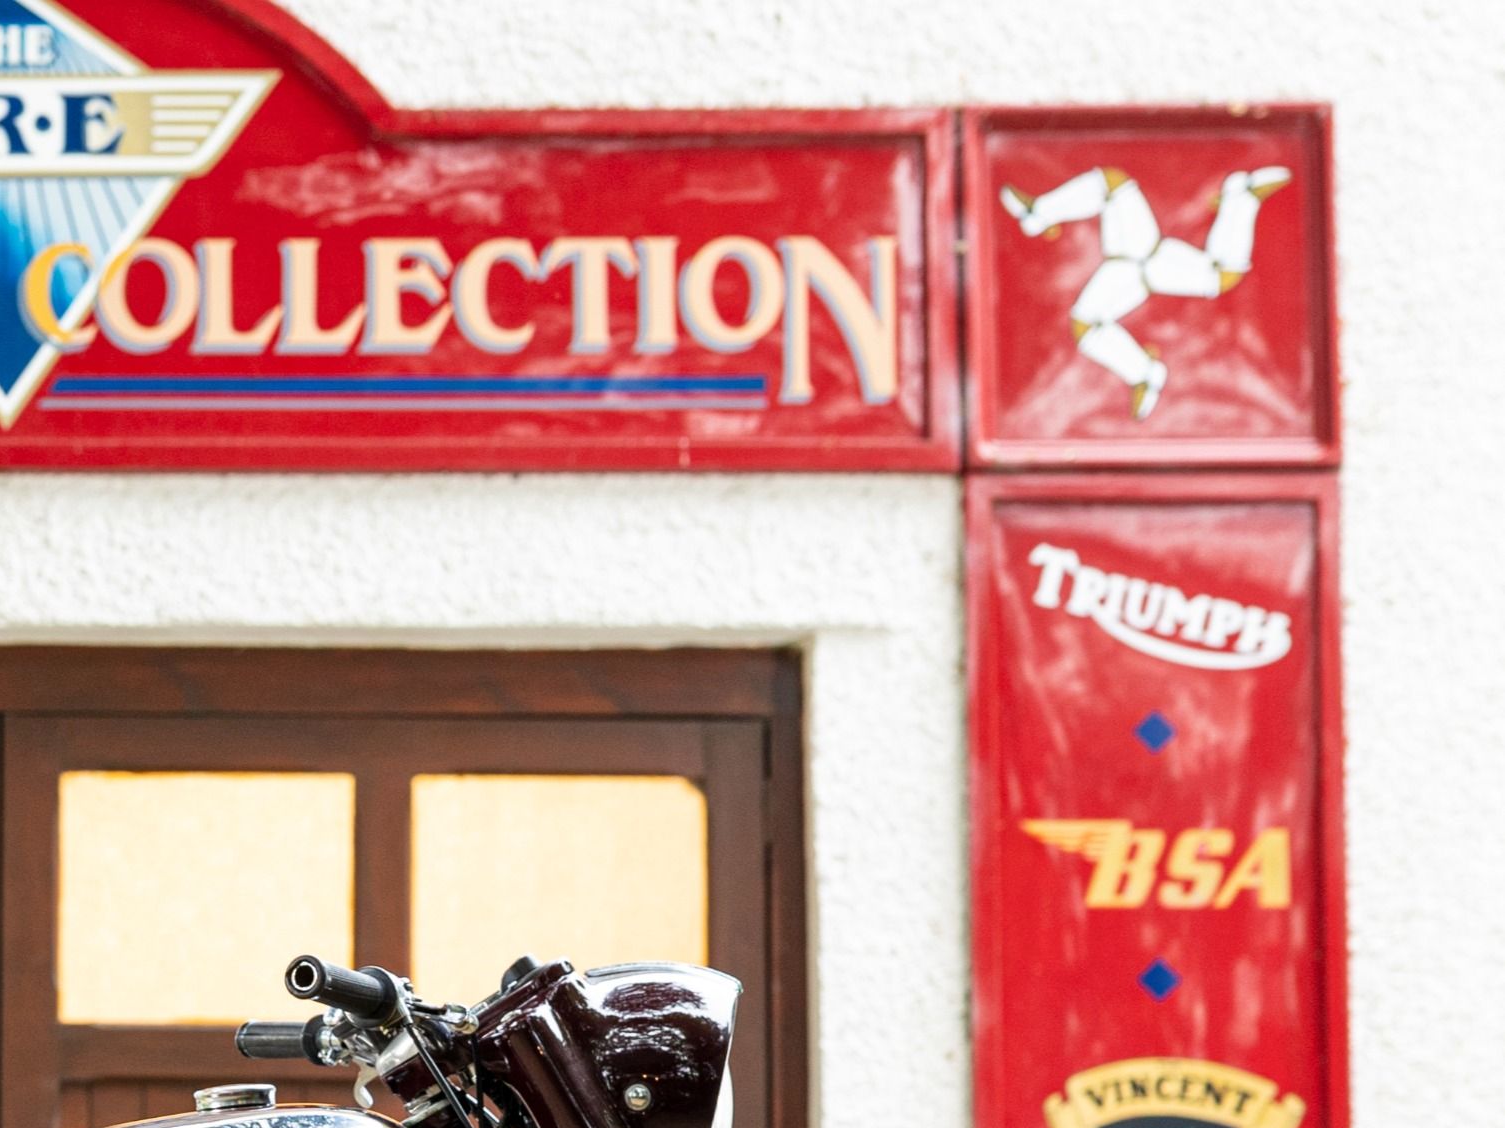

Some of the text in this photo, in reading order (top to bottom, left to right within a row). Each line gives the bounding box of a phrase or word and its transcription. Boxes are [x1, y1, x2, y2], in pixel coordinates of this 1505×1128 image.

[18, 236, 898, 406] COLLECTION
[1028, 541, 1293, 671] TRIUMPH
[1021, 818, 1292, 910] BSA
[1084, 1071, 1259, 1117] VINCENT
